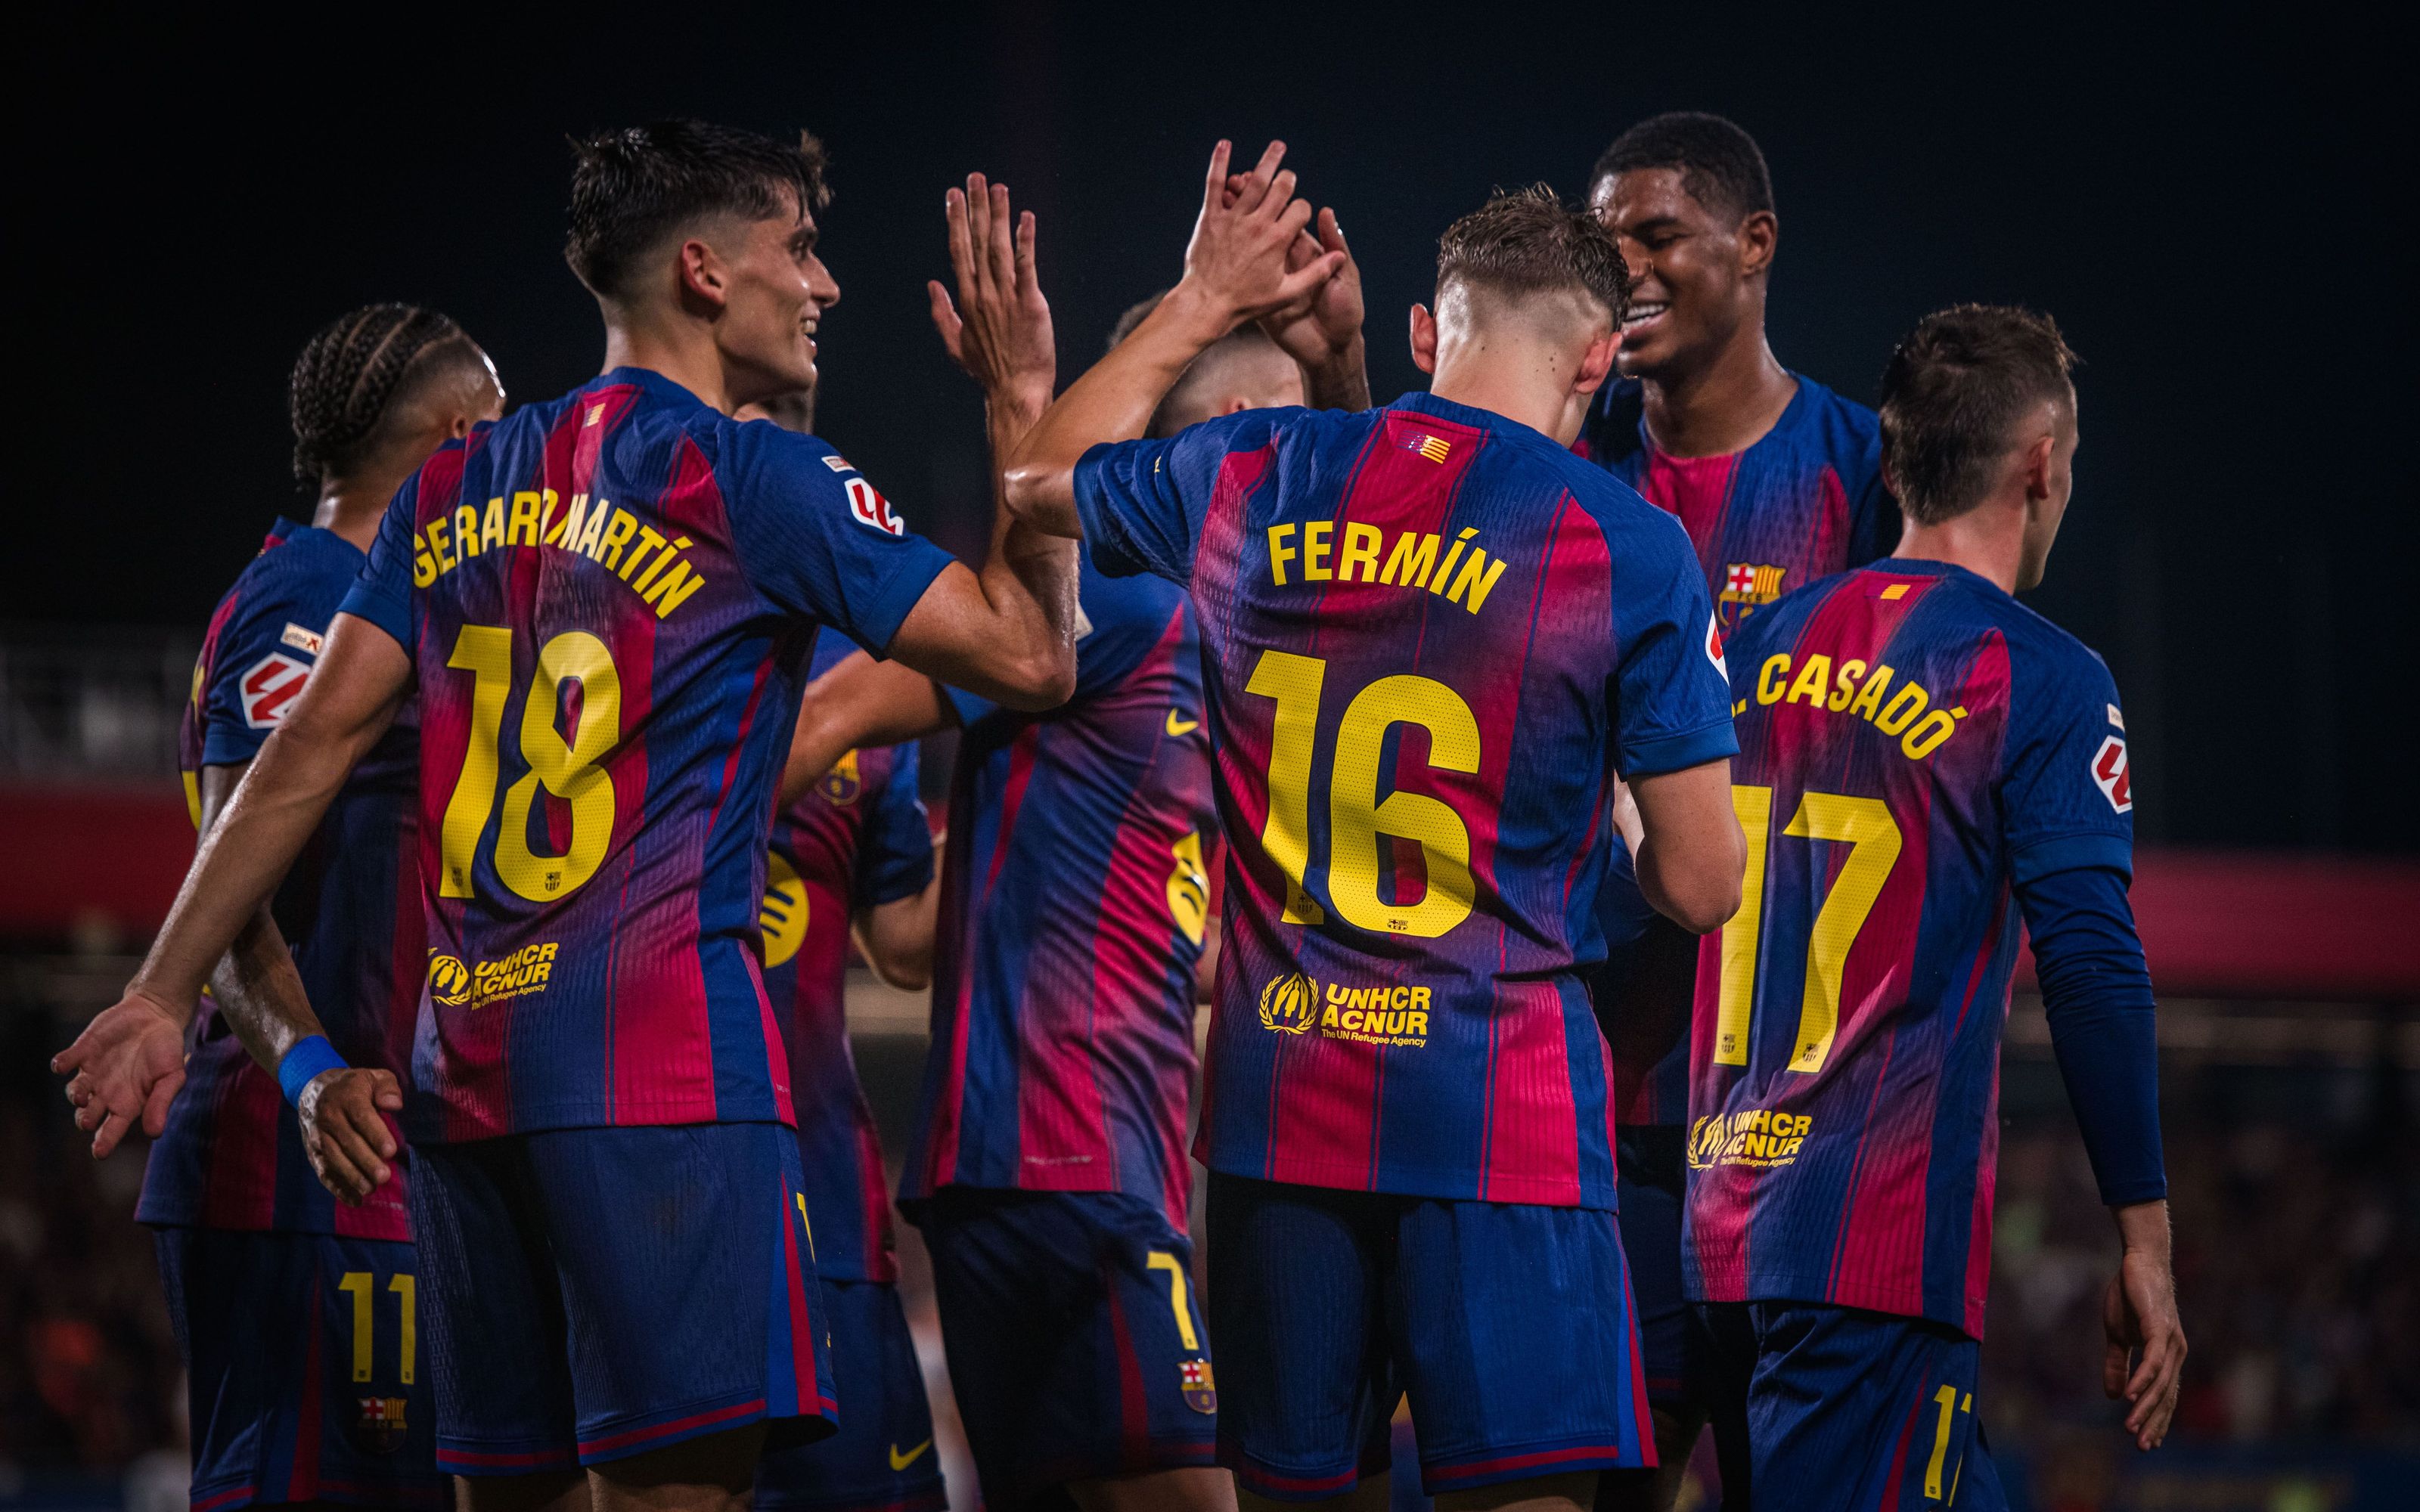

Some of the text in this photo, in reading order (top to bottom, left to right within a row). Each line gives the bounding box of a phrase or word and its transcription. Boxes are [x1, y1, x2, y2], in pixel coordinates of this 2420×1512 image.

[544, 493, 706, 620] MARTÍN
[1267, 522, 1507, 615] FERMÍN
[1756, 652, 1969, 760] CASADÓ
[439, 624, 622, 903] 18
[1245, 649, 1481, 937] 16
[1713, 784, 1903, 1074] 17
[473, 942, 559, 977] UNHCR
[472, 962, 552, 1002] ACNUR
[490, 990, 518, 1003] Refugee
[517, 983, 547, 996] Agency
[1325, 983, 1432, 1011] UNHCR
[1321, 1004, 1429, 1036] ACNUR
[1321, 1028, 1427, 1049] The UN Refugee Agency
[1733, 1109, 1813, 1137] UNHCR
[1722, 1132, 1804, 1159] ACNUR
[1736, 1156, 1769, 1168] Refugee
[1768, 1157, 1796, 1168] Agency
[1146, 1251, 1199, 1351] 7
[338, 1272, 415, 1384] 11
